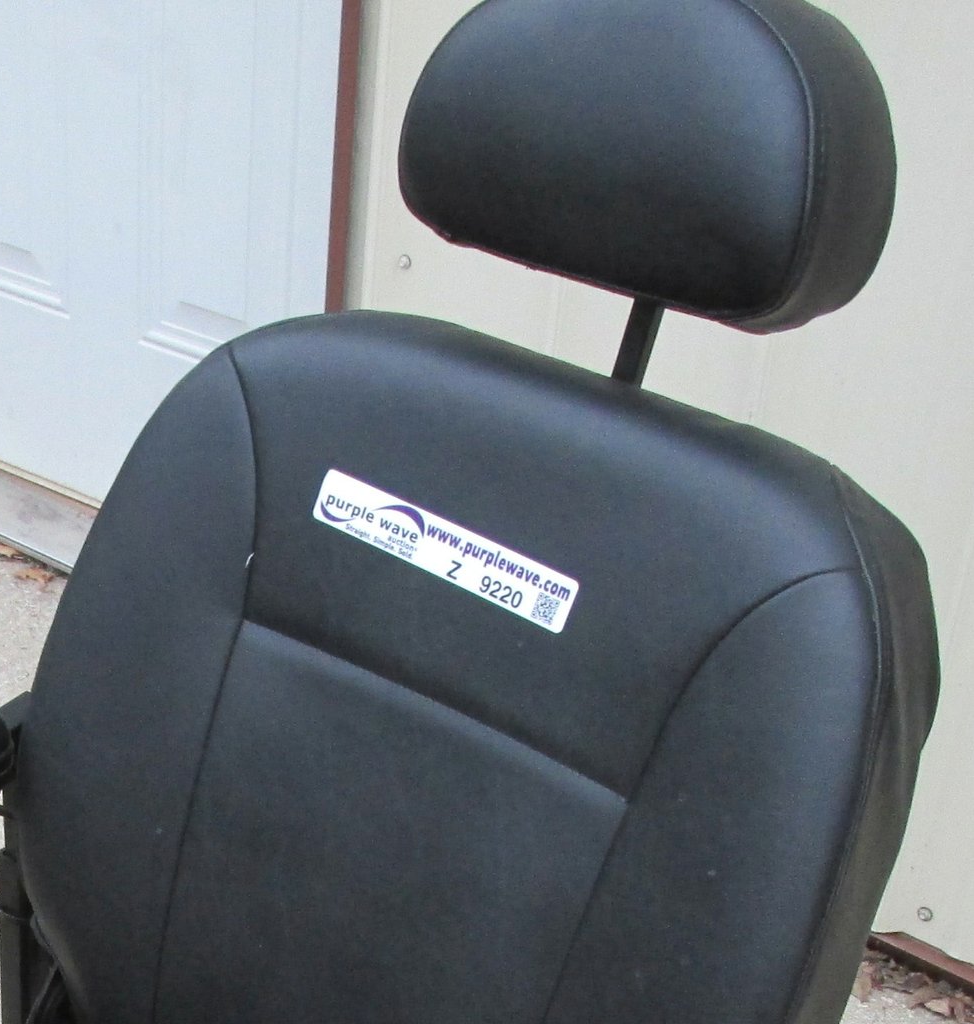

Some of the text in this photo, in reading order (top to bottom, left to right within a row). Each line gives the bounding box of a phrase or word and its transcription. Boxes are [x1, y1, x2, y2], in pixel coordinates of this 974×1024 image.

[326, 494, 419, 544] purple wave
[426, 524, 572, 602] www.purplewave.com
[446, 560, 523, 609] Z 9220
